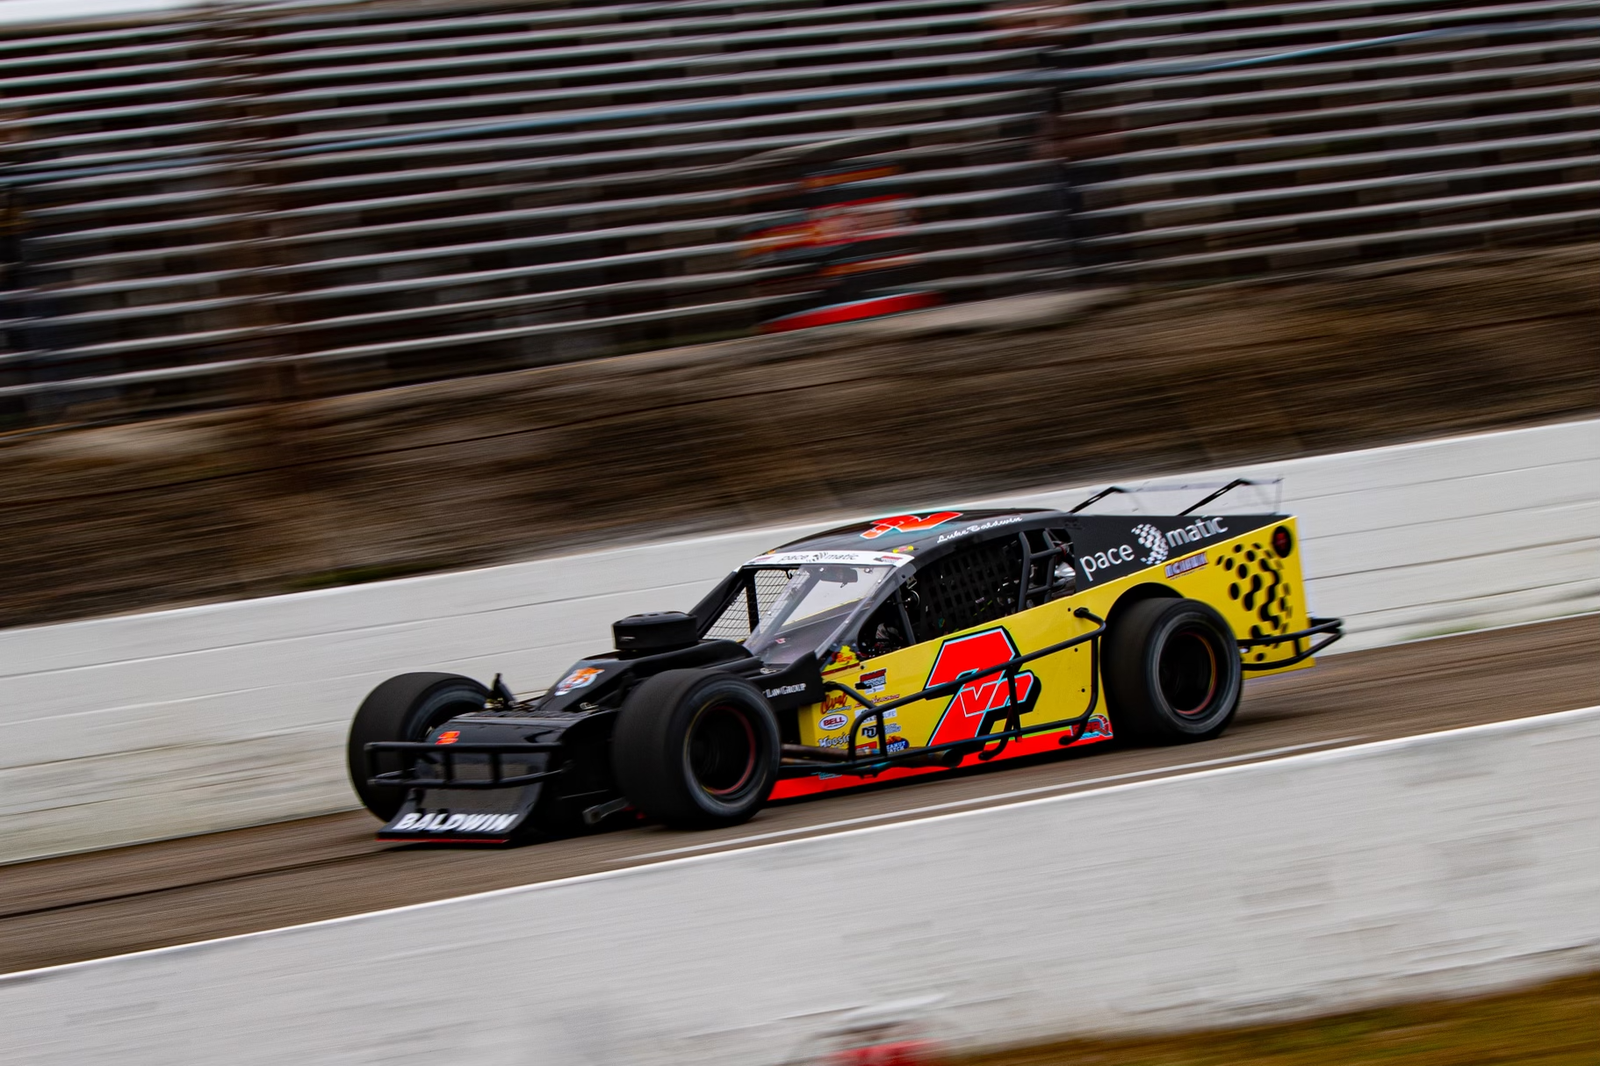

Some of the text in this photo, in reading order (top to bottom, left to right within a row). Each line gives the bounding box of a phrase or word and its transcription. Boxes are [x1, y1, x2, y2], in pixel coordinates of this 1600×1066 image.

[937, 530, 968, 543] Luke
[966, 516, 1023, 532] Baldwin
[780, 554, 810, 563] pace
[826, 551, 860, 561] matic
[1079, 544, 1135, 582] pace
[1164, 515, 1229, 548] matic
[823, 717, 844, 727] BELL
[391, 812, 519, 832] BALDWIN
